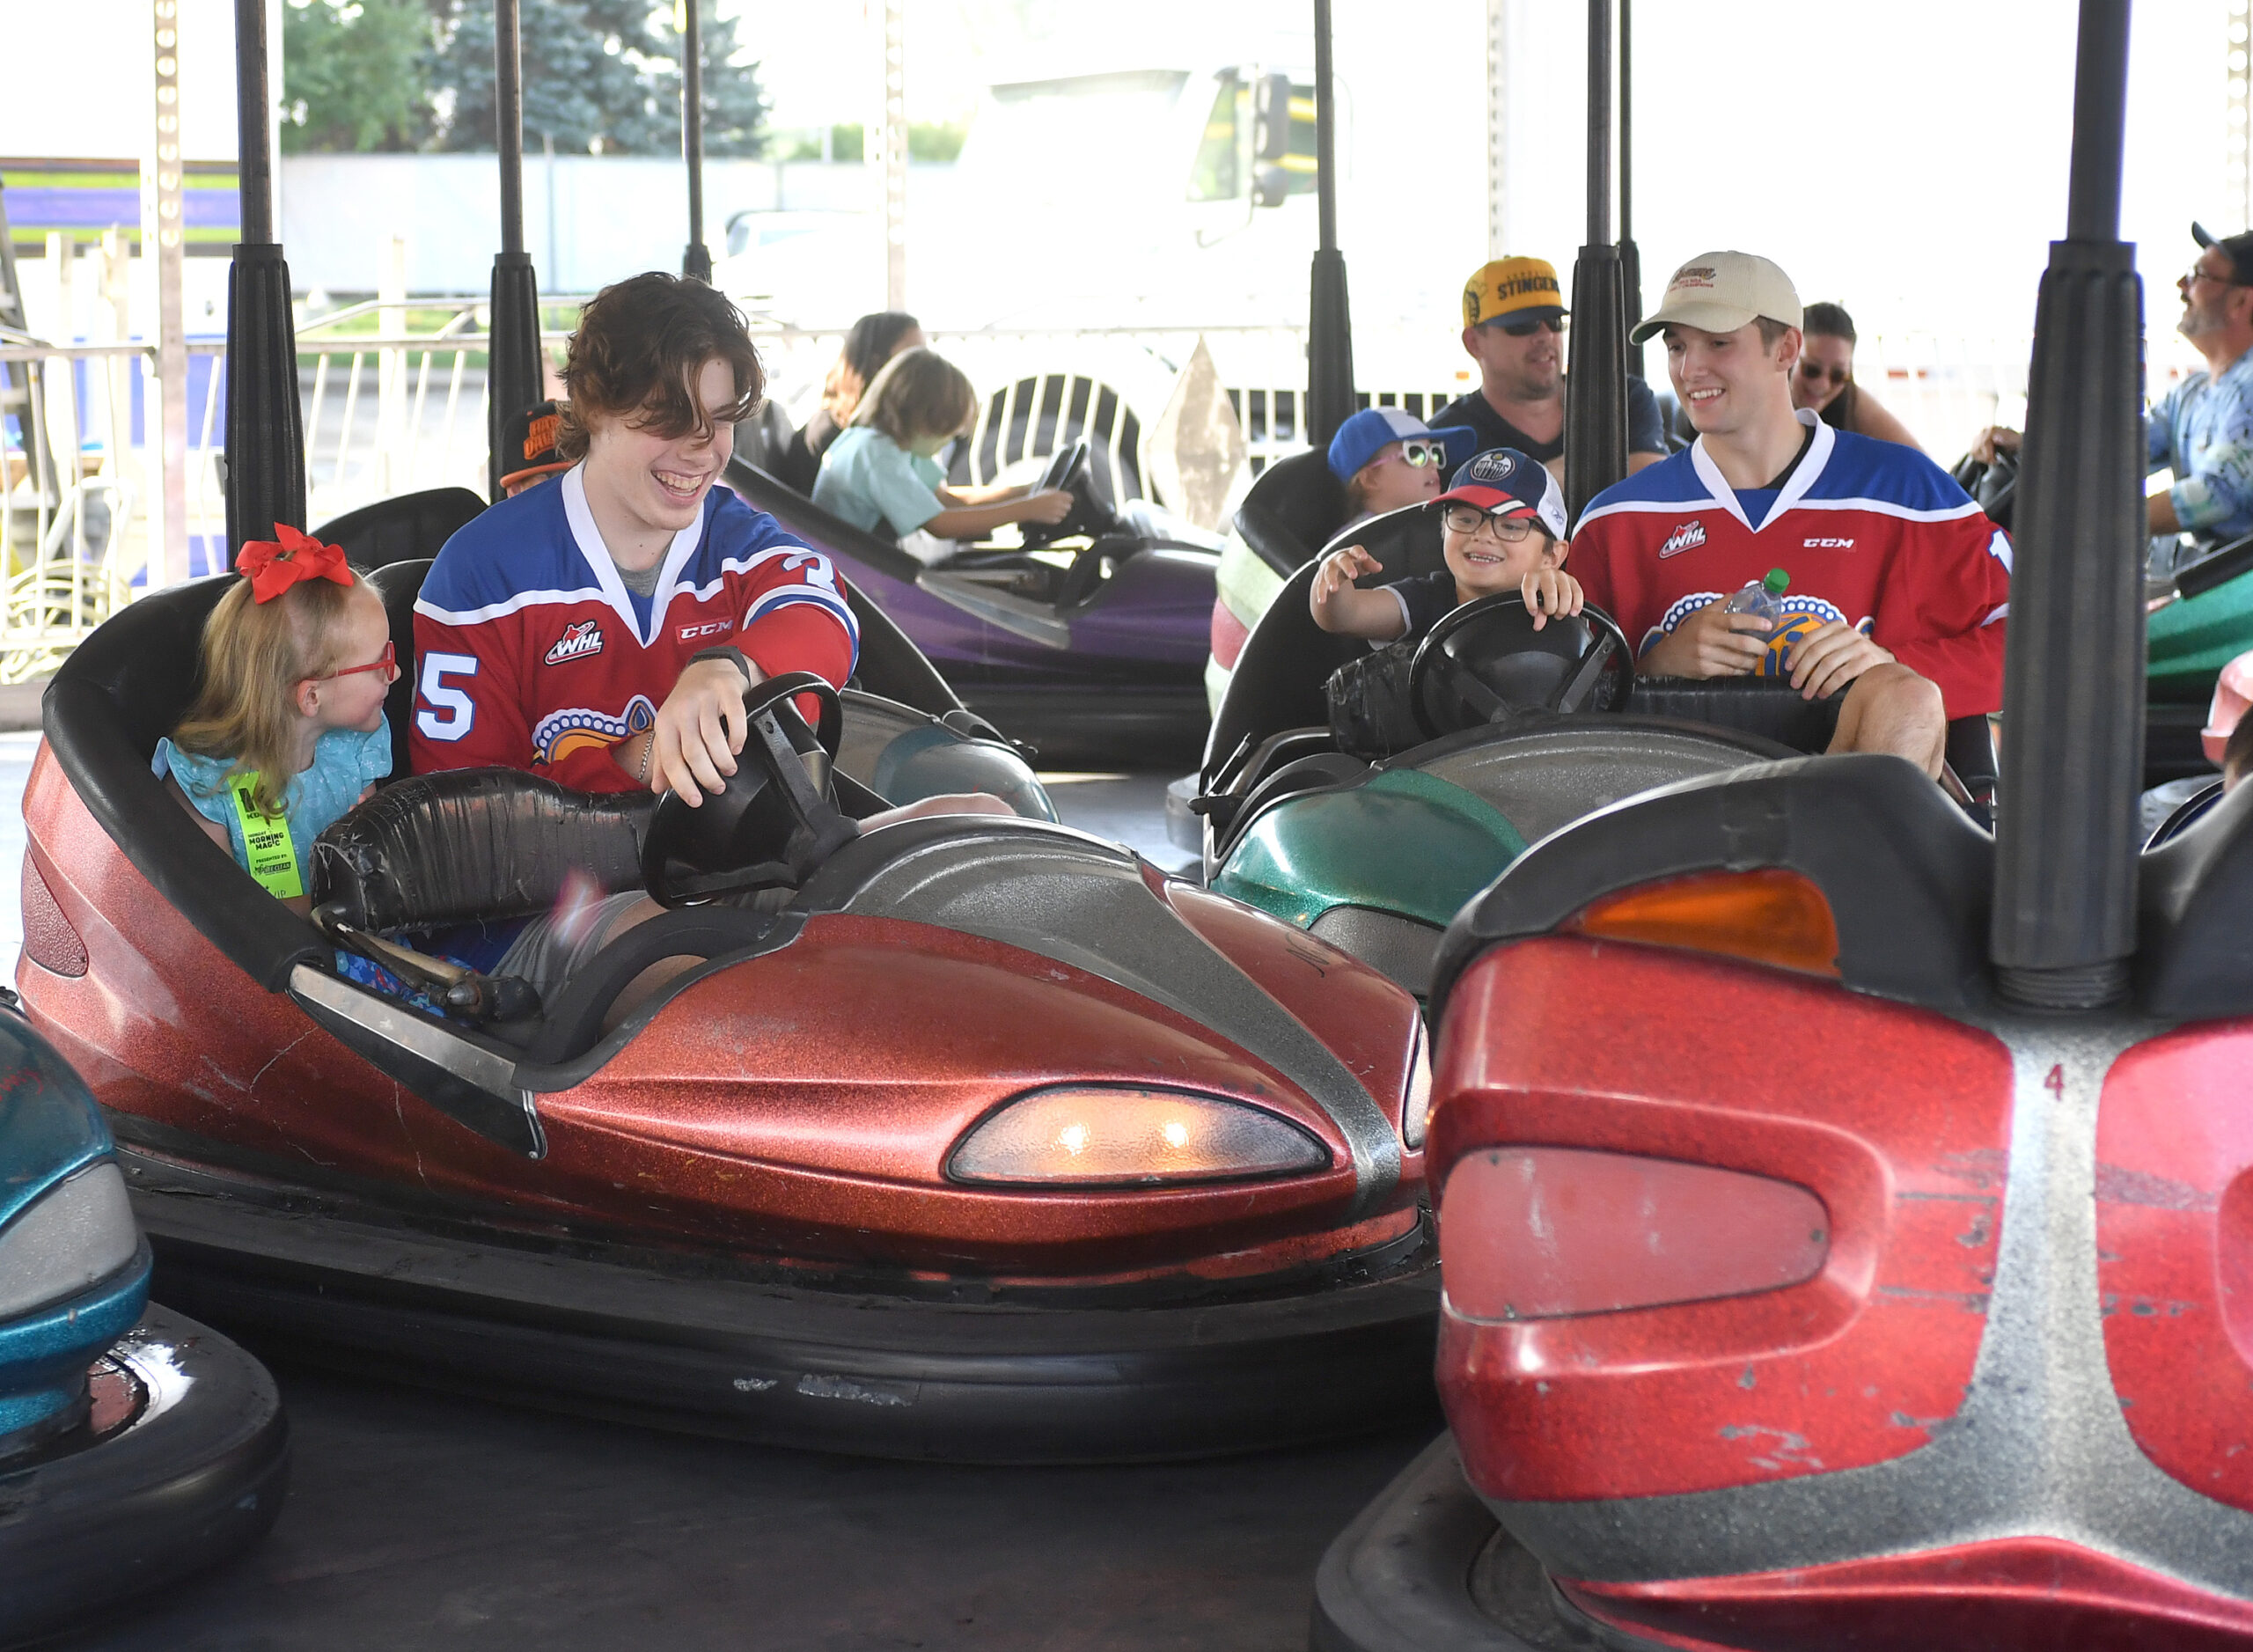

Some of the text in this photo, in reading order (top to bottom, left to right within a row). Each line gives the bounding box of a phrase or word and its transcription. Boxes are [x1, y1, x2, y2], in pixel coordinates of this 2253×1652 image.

[1668, 527, 1706, 551] WHL
[1803, 538, 1854, 548] CCM
[681, 620, 733, 639] CCM
[557, 631, 603, 657] WHL
[411, 650, 480, 742] 5
[249, 832, 284, 845] MORNING
[2044, 1064, 2065, 1101] 4
